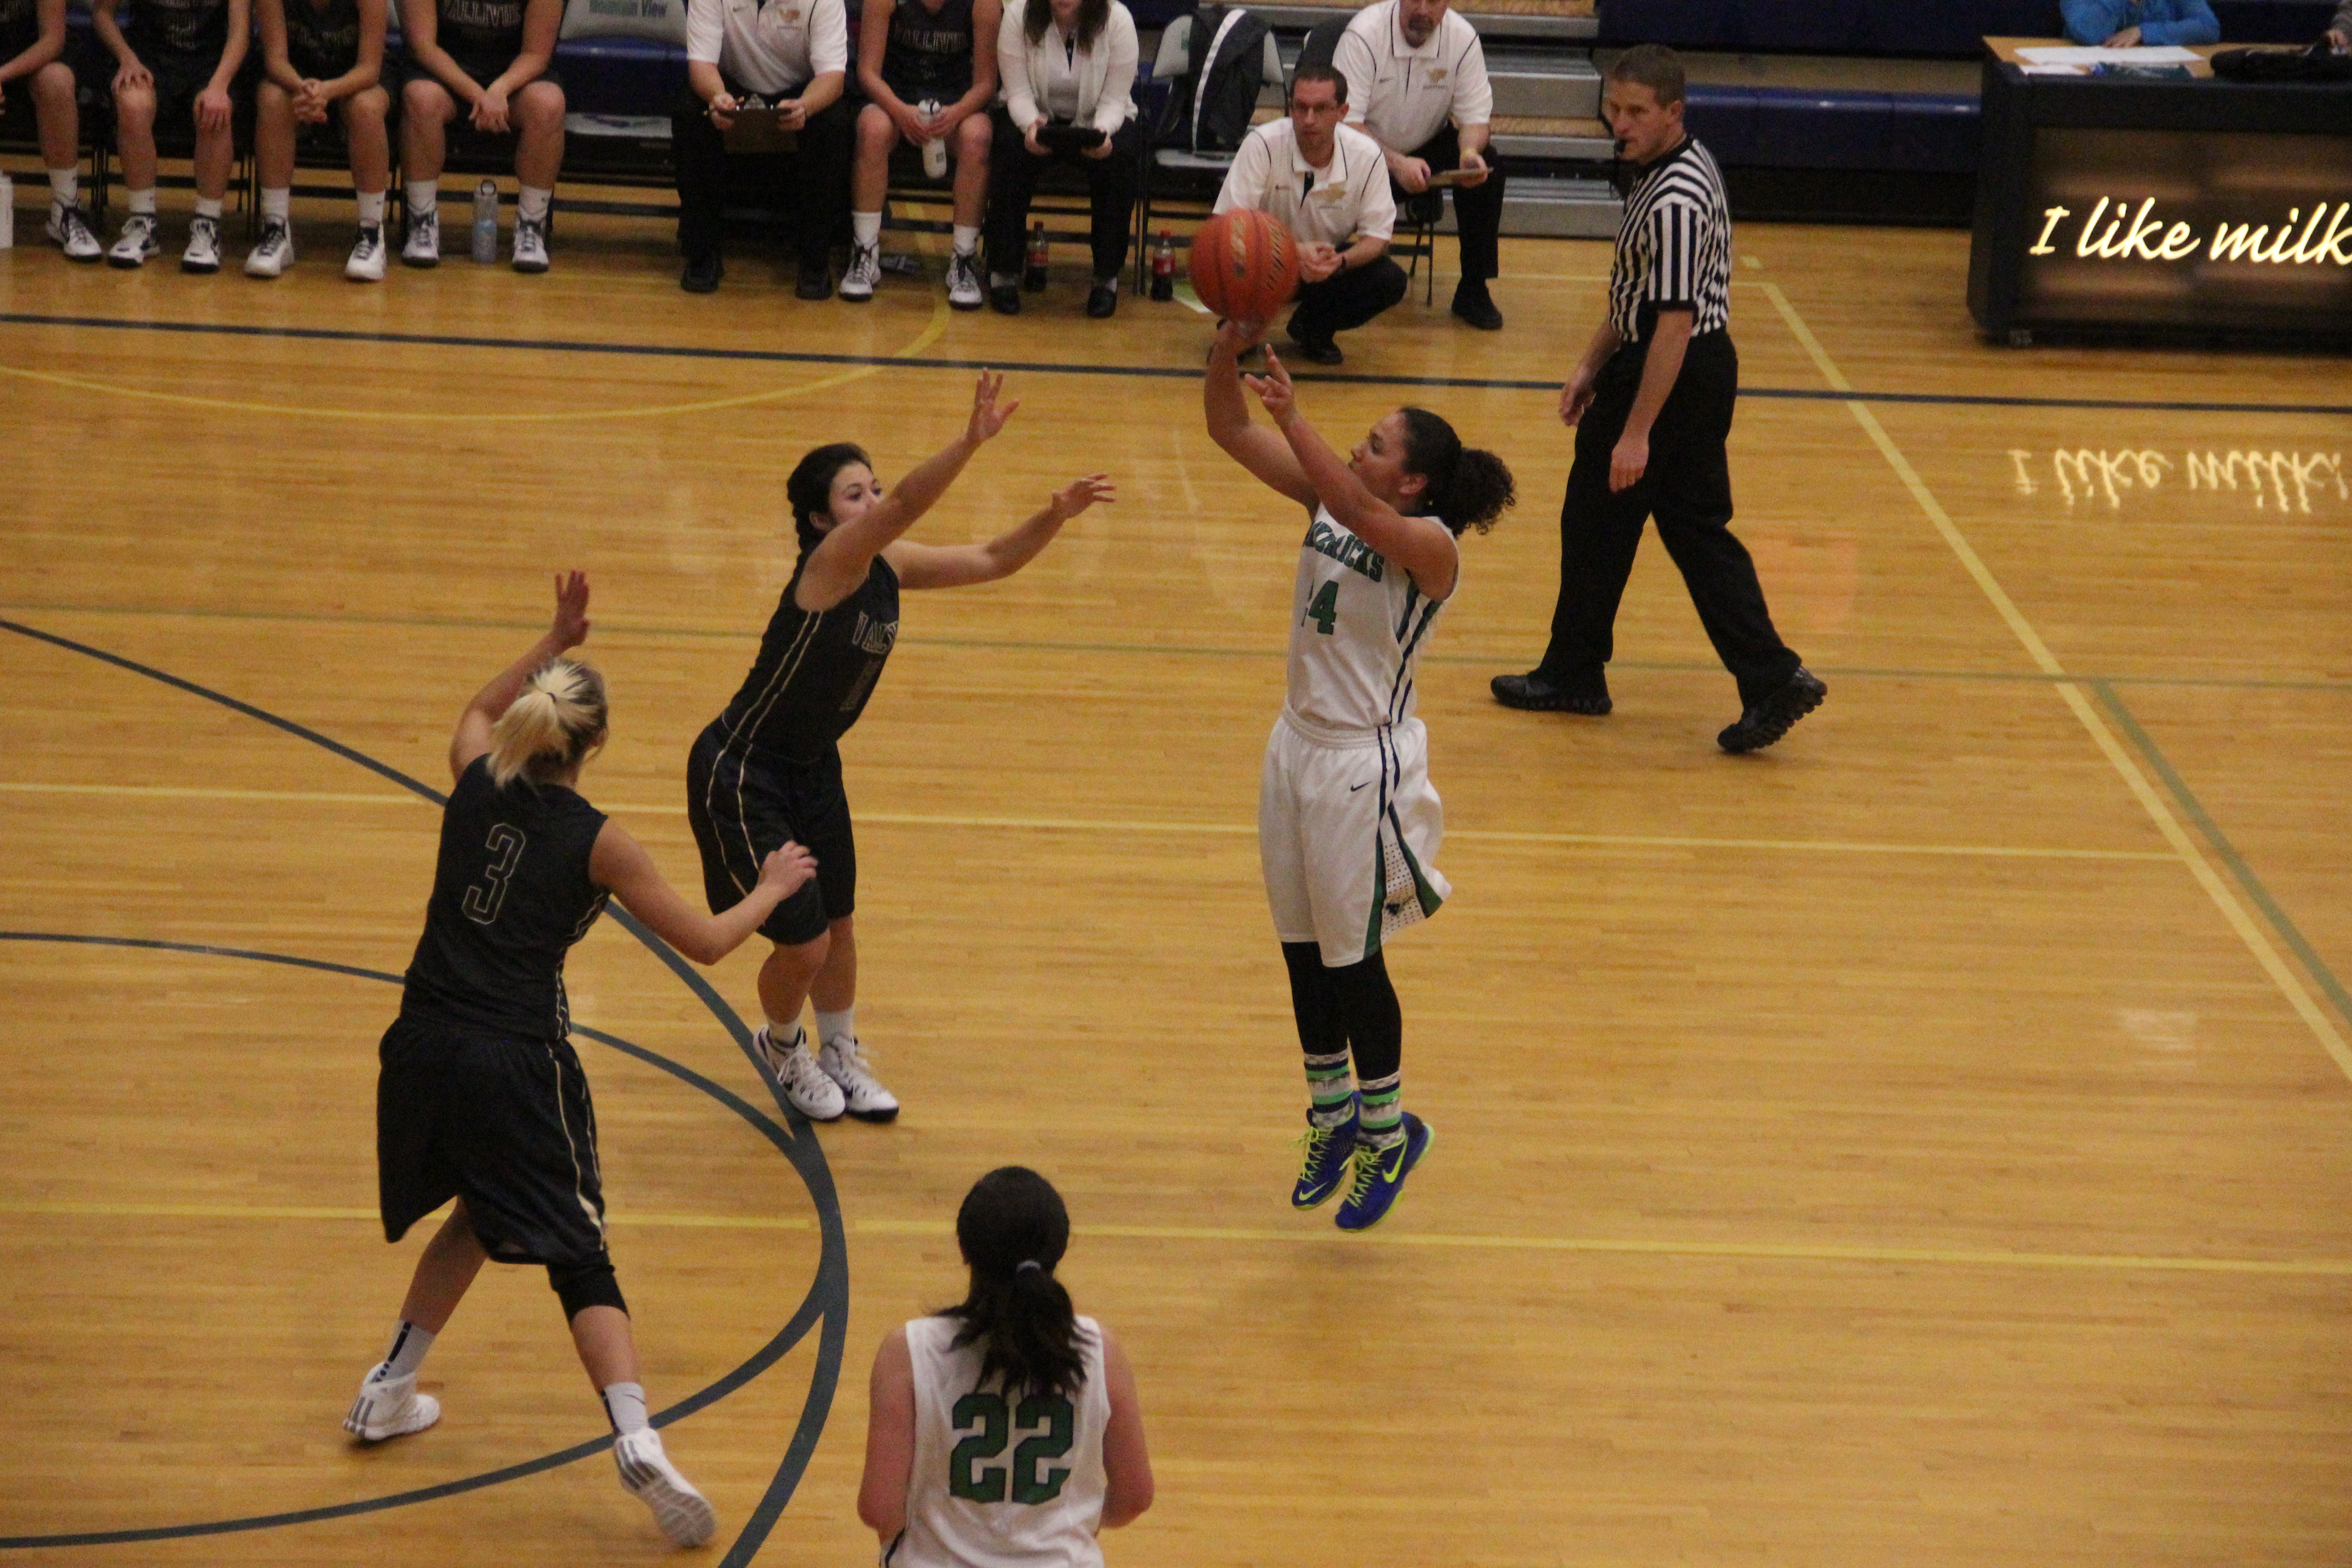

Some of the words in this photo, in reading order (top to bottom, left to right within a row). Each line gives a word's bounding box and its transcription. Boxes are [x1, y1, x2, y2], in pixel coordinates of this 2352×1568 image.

[2030, 206, 2071, 255] I
[2077, 196, 2200, 260] like
[2209, 202, 2352, 265] milk
[461, 823, 526, 925] 3
[950, 1393, 1073, 1505] 22
